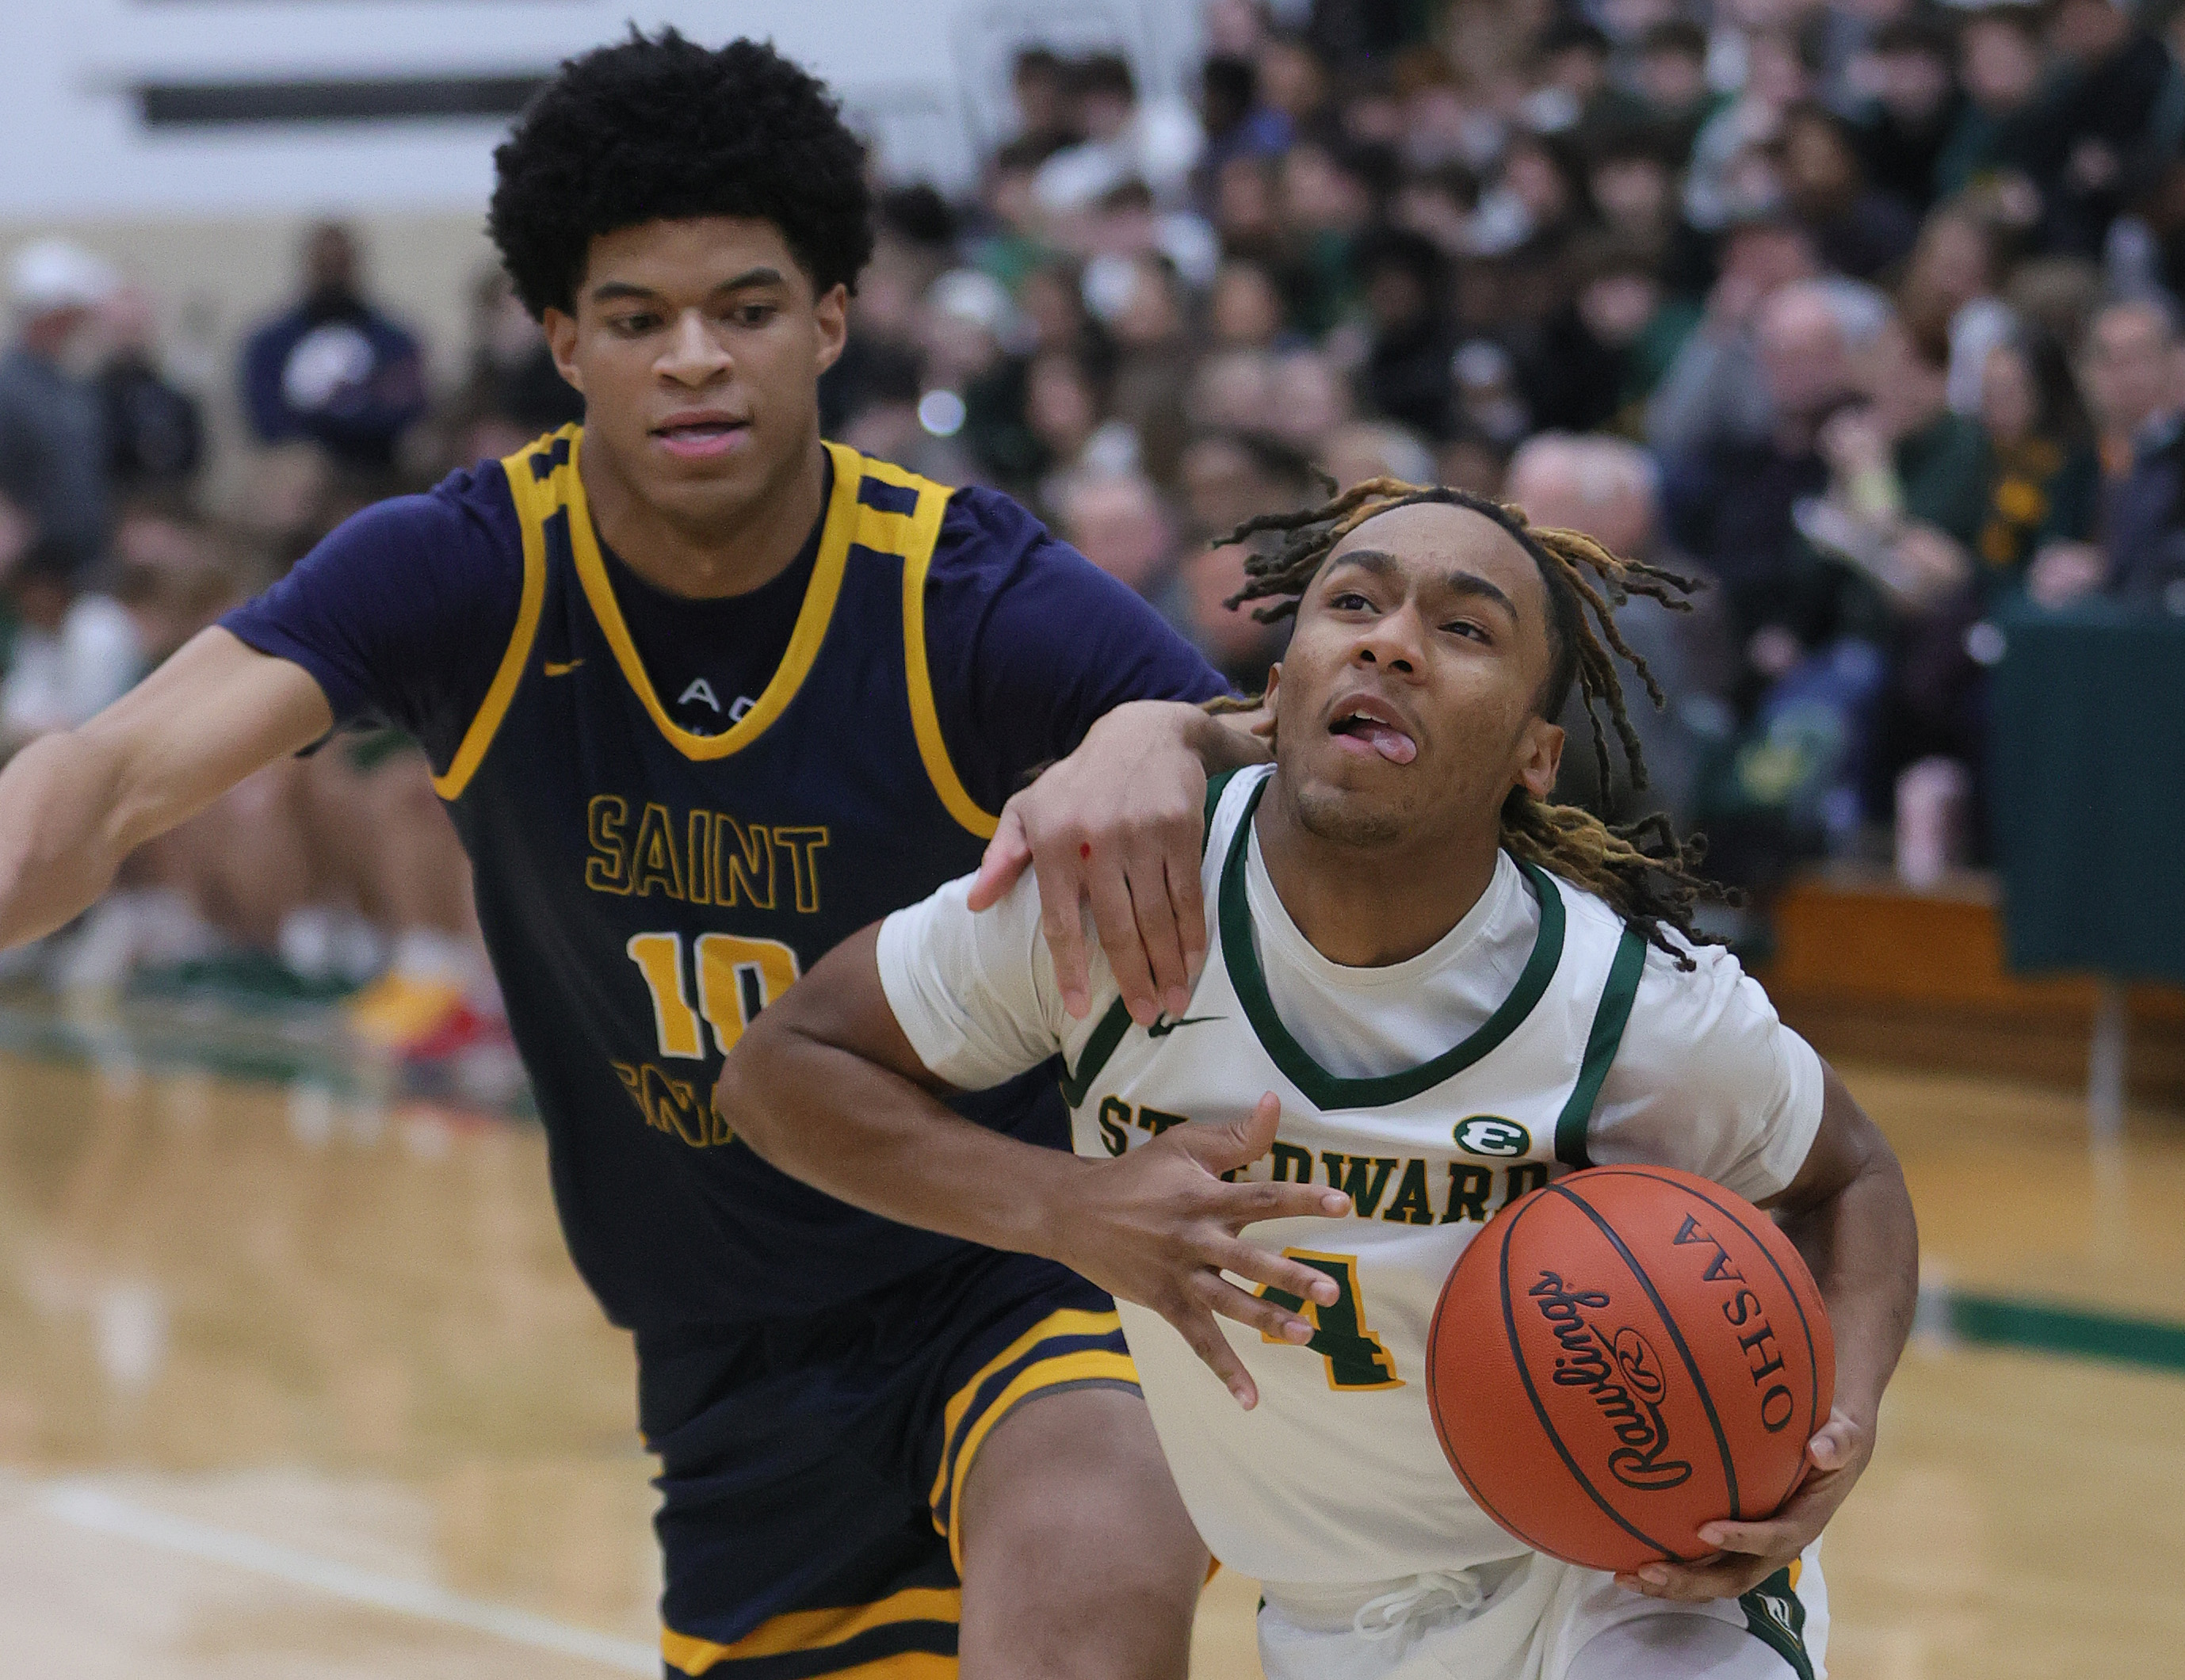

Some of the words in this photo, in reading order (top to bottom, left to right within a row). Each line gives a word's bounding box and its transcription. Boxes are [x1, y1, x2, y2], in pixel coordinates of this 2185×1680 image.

[586, 794, 829, 913] SAINT
[626, 931, 800, 1060] 10
[1220, 1139, 1550, 1225] DWARD
[1253, 1247, 1407, 1392] 4
[1529, 1270, 1693, 1491] Rawlings
[1673, 1212, 1793, 1434] OHSAA
